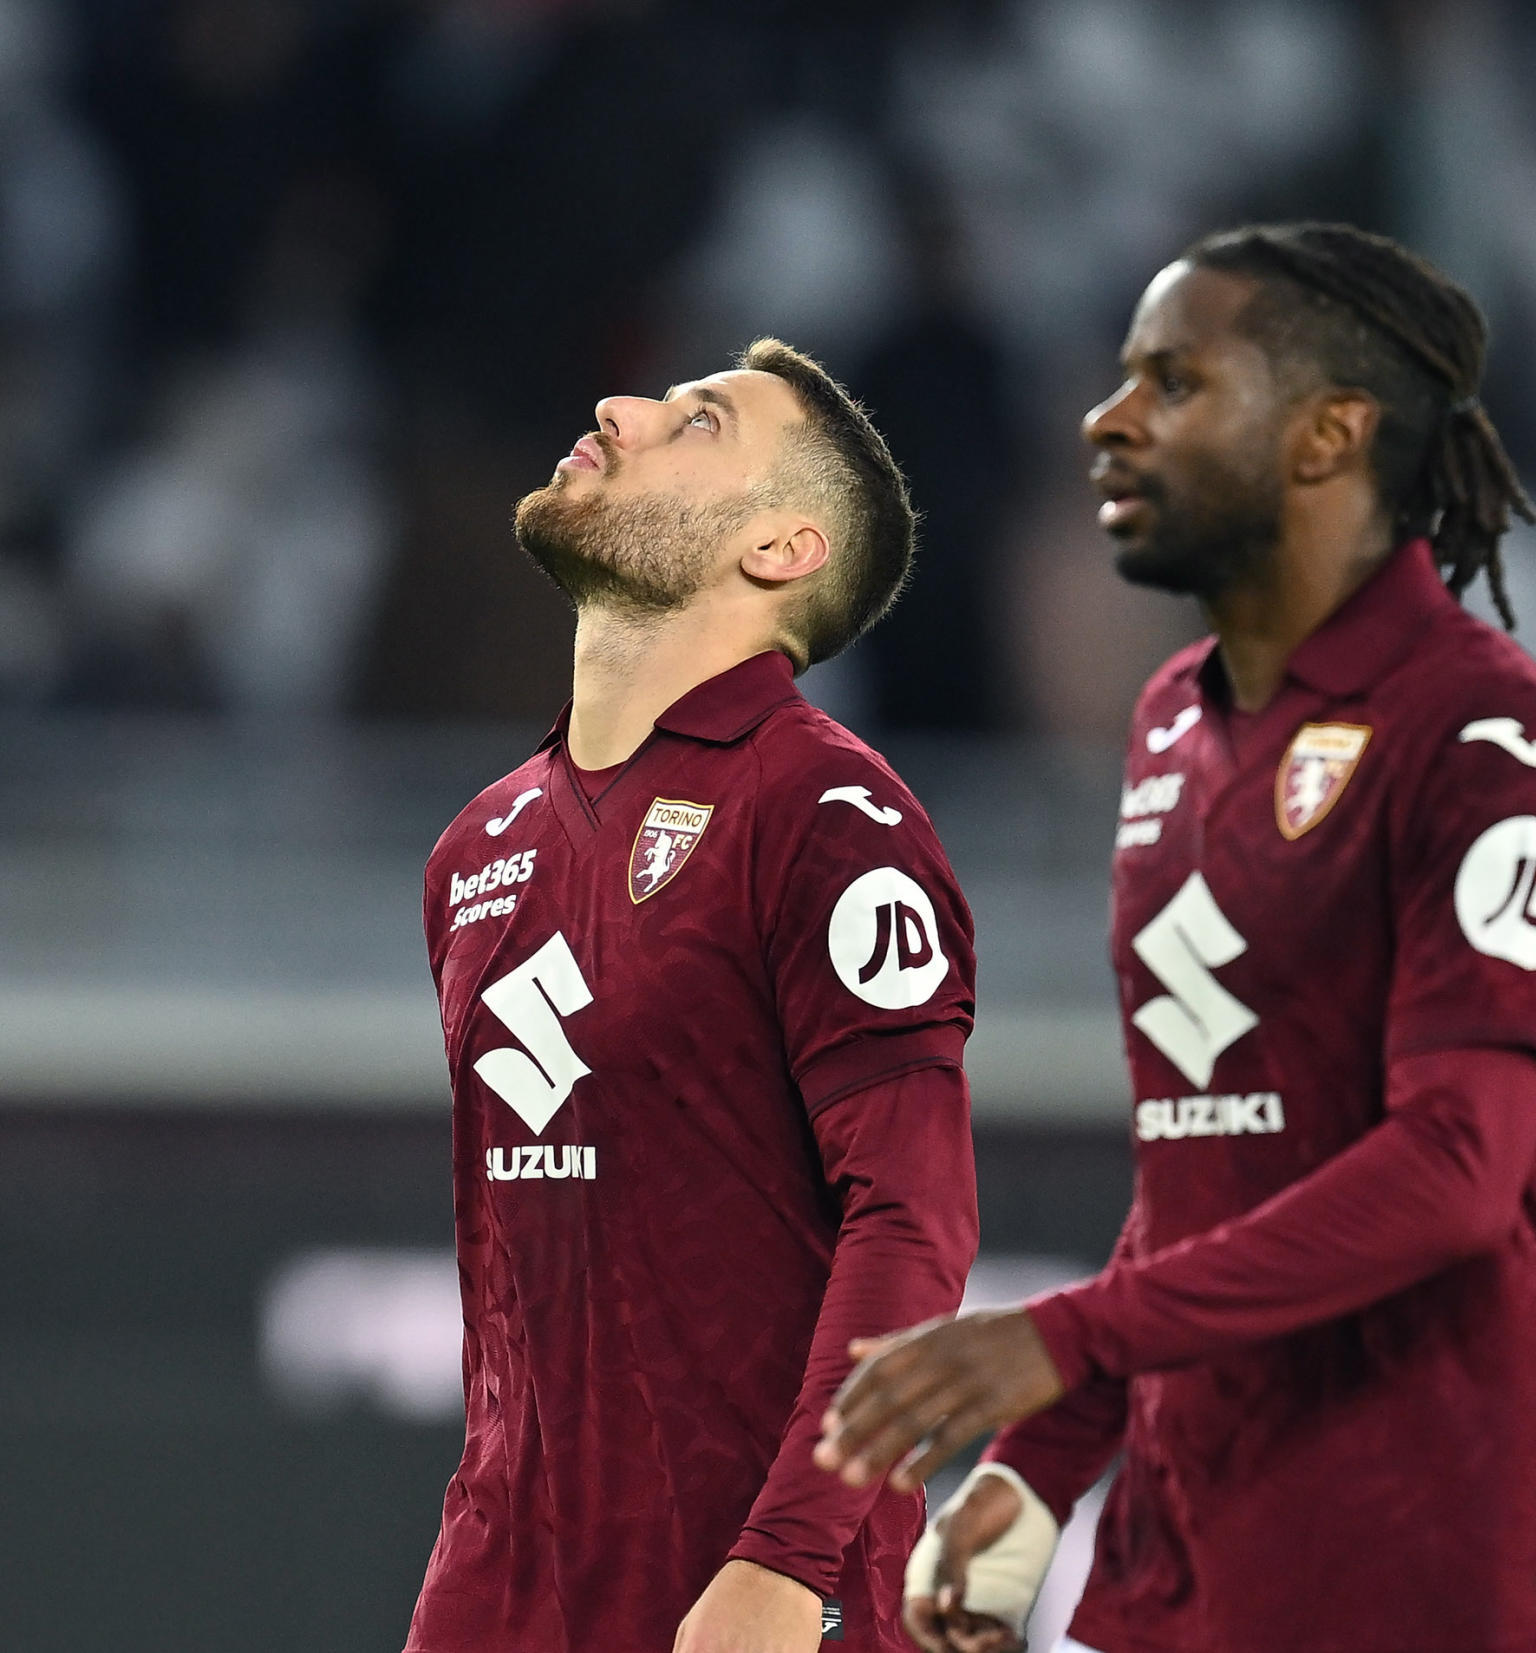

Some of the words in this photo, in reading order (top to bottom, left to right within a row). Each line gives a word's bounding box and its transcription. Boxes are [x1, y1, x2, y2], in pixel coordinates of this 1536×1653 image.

[653, 808, 702, 827] TORINO
[672, 833, 693, 850] FC
[449, 848, 537, 907] bet365
[858, 900, 933, 984] JD
